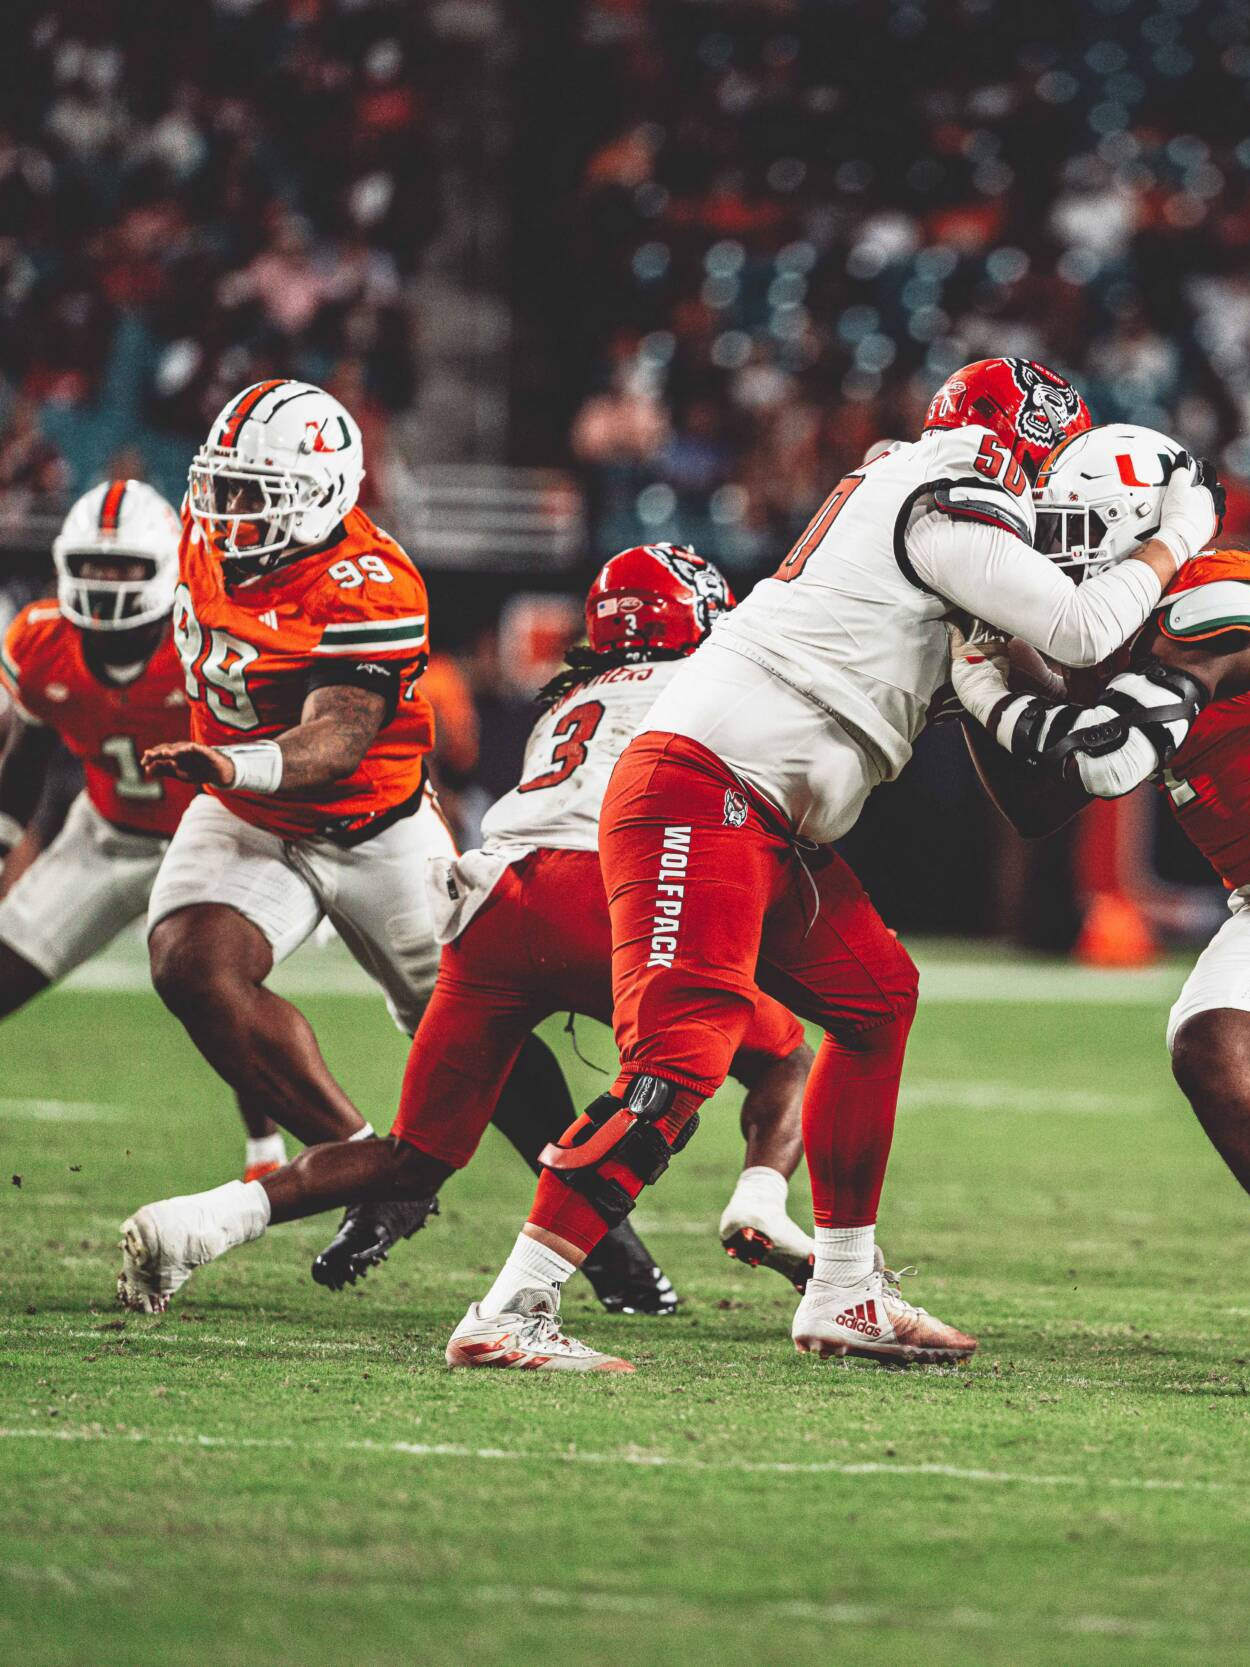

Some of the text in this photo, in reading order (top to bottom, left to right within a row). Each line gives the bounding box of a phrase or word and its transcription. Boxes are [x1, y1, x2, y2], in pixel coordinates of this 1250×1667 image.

[973, 434, 1026, 498] 50
[1115, 453, 1174, 488] U
[327, 554, 394, 589] 99
[624, 613, 638, 636] 3
[173, 583, 260, 731] 99
[101, 735, 163, 800] 1
[517, 700, 606, 794] 3
[646, 826, 692, 968] WOLFPACK
[835, 1314, 882, 1338] adidas
